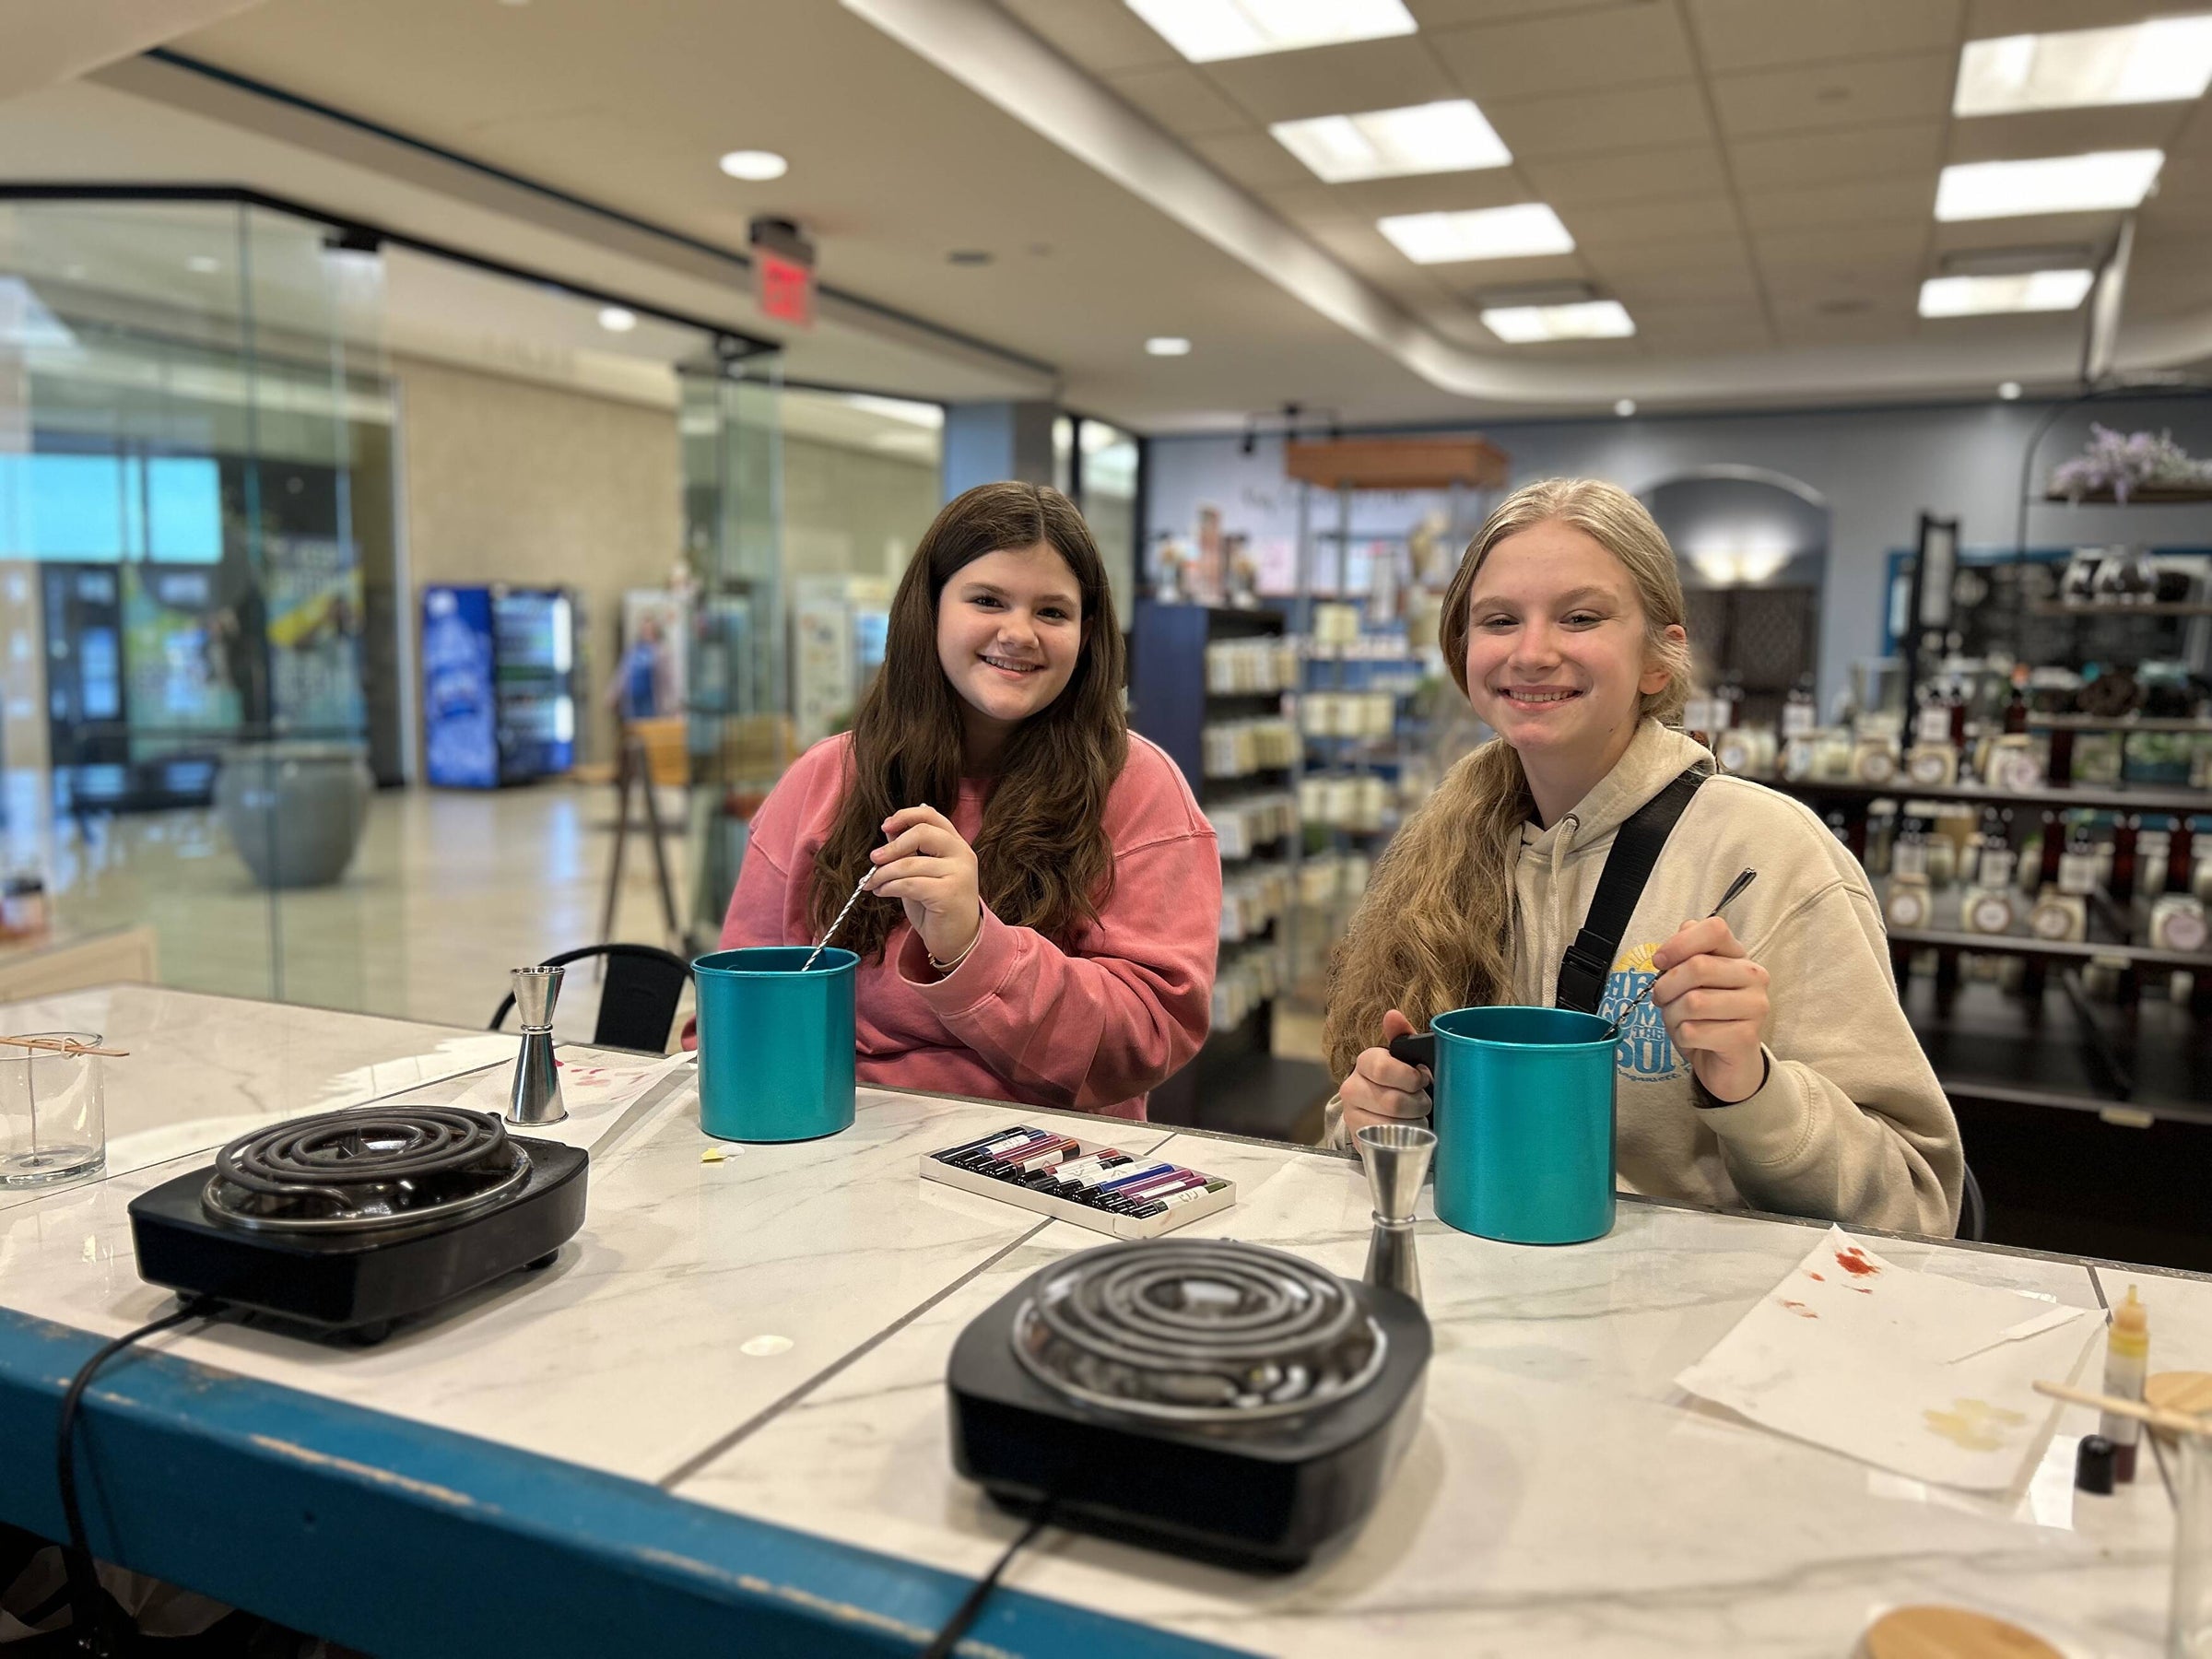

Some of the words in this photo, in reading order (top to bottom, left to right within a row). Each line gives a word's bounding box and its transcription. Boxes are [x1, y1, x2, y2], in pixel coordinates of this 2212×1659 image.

[1605, 968, 1657, 1004] HE
[1598, 997, 1664, 1029] COM
[1633, 1027, 1665, 1040] THE
[1617, 1030, 1676, 1074] SU
